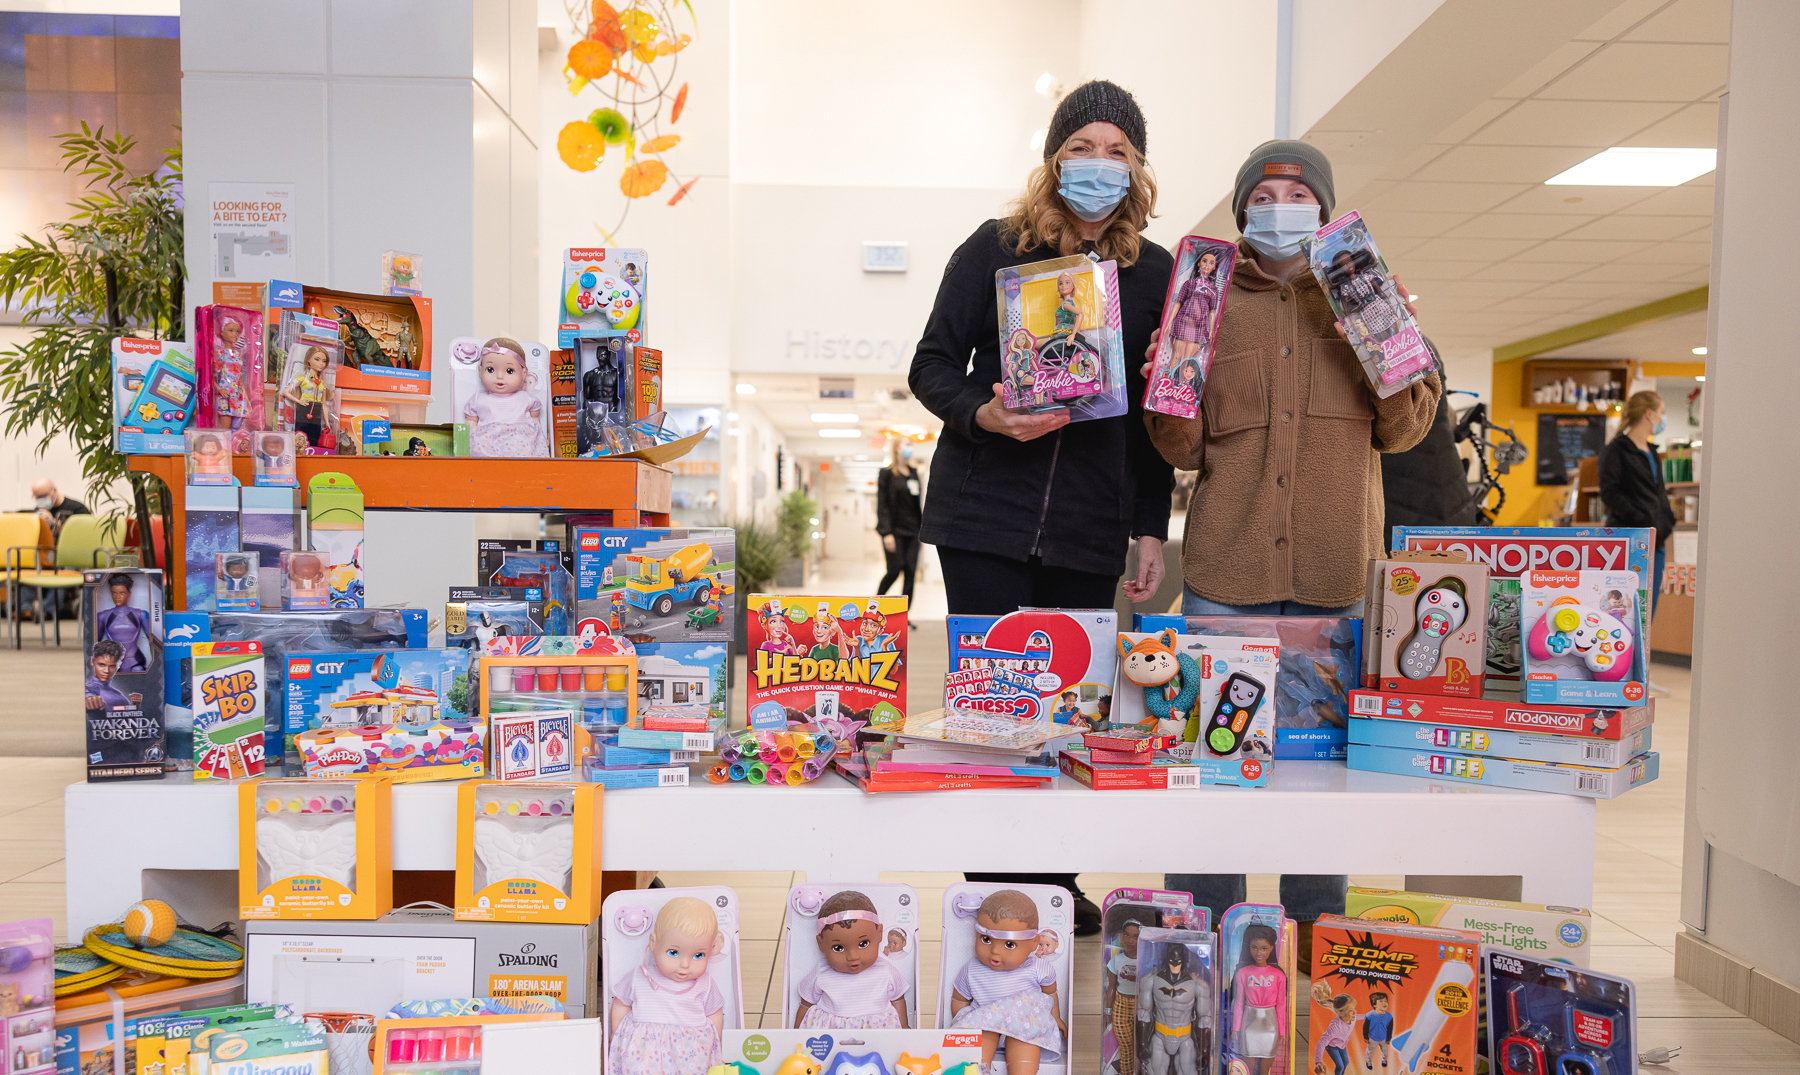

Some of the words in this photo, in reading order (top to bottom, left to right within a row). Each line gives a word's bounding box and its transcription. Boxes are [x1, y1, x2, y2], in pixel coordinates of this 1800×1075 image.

[213, 201, 259, 211] LOOKING
[261, 202, 282, 212] FOR
[213, 212, 221, 221] A
[223, 212, 245, 221] BITE
[247, 212, 260, 222] TO
[262, 213, 287, 222] EAT?
[572, 250, 604, 258] fisher-price
[314, 320, 337, 329] PARAMEDIC
[122, 342, 161, 351] fisher-price
[785, 328, 908, 368] History
[1381, 335, 1418, 360] Barbie
[1033, 371, 1075, 393] Barbie
[642, 385, 657, 396] 100
[1154, 378, 1195, 402] Barbie
[581, 538, 599, 546] LEGO
[603, 536, 629, 547] CITY
[1395, 576, 1412, 587] 25+
[1533, 574, 1577, 583] fisher-price
[1664, 563, 1697, 595] FFE
[290, 664, 310, 673] LEGO
[315, 662, 345, 674] CITY
[751, 648, 903, 692] HEDBANZ
[289, 683, 301, 691] 5+
[771, 687, 791, 696] QUICK
[791, 684, 825, 692] QUESTION
[855, 686, 877, 696] "WHAT
[1593, 690, 1617, 698] Learn
[218, 692, 255, 721] BO
[88, 718, 160, 731] WAKANDA
[755, 715, 783, 724] ANIMAL?
[1508, 711, 1580, 727] MONOPOLY
[505, 723, 534, 743] BICYCLE
[540, 718, 568, 738] BICYCLE
[92, 728, 161, 741] FOREVER
[1415, 731, 1435, 741] Game
[1436, 729, 1486, 750] LIFE
[244, 745, 265, 763] 12
[318, 750, 362, 766] Play-Doh
[1411, 758, 1432, 767] Game
[1432, 757, 1480, 778] LIFE
[90, 769, 110, 777] TITAN
[111, 768, 134, 776] HERO
[135, 767, 162, 775] SERIES
[506, 770, 535, 779] STANDARD
[541, 765, 569, 773] STANDARD
[1464, 918, 1535, 935] Mess-Free
[1562, 927, 1581, 935] 24+
[1484, 932, 1548, 950] ch-Lights
[1331, 944, 1415, 962] STOMP
[498, 953, 558, 968] SPALDING
[1320, 954, 1419, 975] ROCKET
[1497, 955, 1524, 968] STAR
[1493, 959, 1524, 975] WARS
[1338, 967, 1356, 975] 100%
[1368, 971, 1401, 981] POWERED
[493, 979, 511, 990] 180°
[513, 980, 539, 991] ARENA
[1437, 999, 1469, 1011] EXCELLENCE
[138, 1024, 155, 1036] 10
[166, 1026, 183, 1038] 10
[183, 1022, 205, 1031] Classic
[1578, 1024, 1609, 1035] ADVENTURES
[955, 1034, 979, 1044] gaga!
[1584, 1030, 1602, 1038] ACROSS
[1588, 1035, 1608, 1044] GALAXY!
[291, 1037, 323, 1048] Washable
[1440, 1044, 1452, 1056] 4
[1434, 1056, 1457, 1064] FOAM
[1427, 1062, 1463, 1072] ROCKETS
